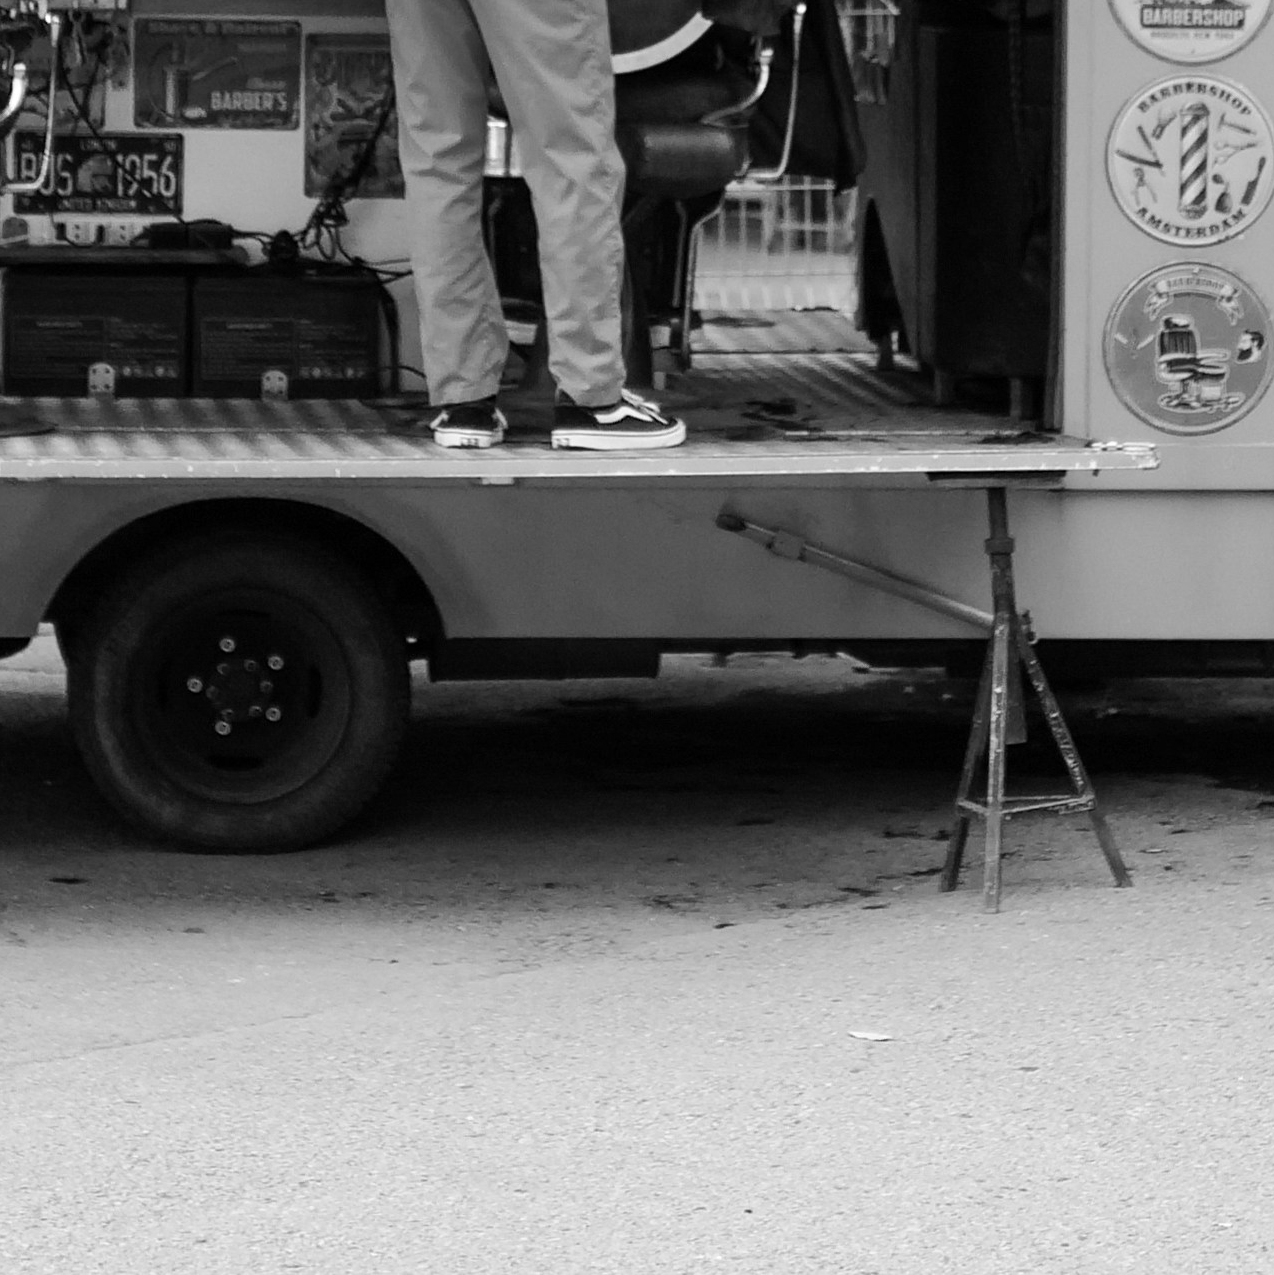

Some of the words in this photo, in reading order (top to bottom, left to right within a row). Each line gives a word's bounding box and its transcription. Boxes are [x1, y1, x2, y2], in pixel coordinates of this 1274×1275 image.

[1141, 10, 1245, 28] BARBERSHOP
[211, 91, 288, 112] BARBER'S
[1137, 81, 1253, 116] BARBERSHOP
[115, 153, 177, 198] 1956
[1137, 206, 1248, 240] AMSTERDAM
